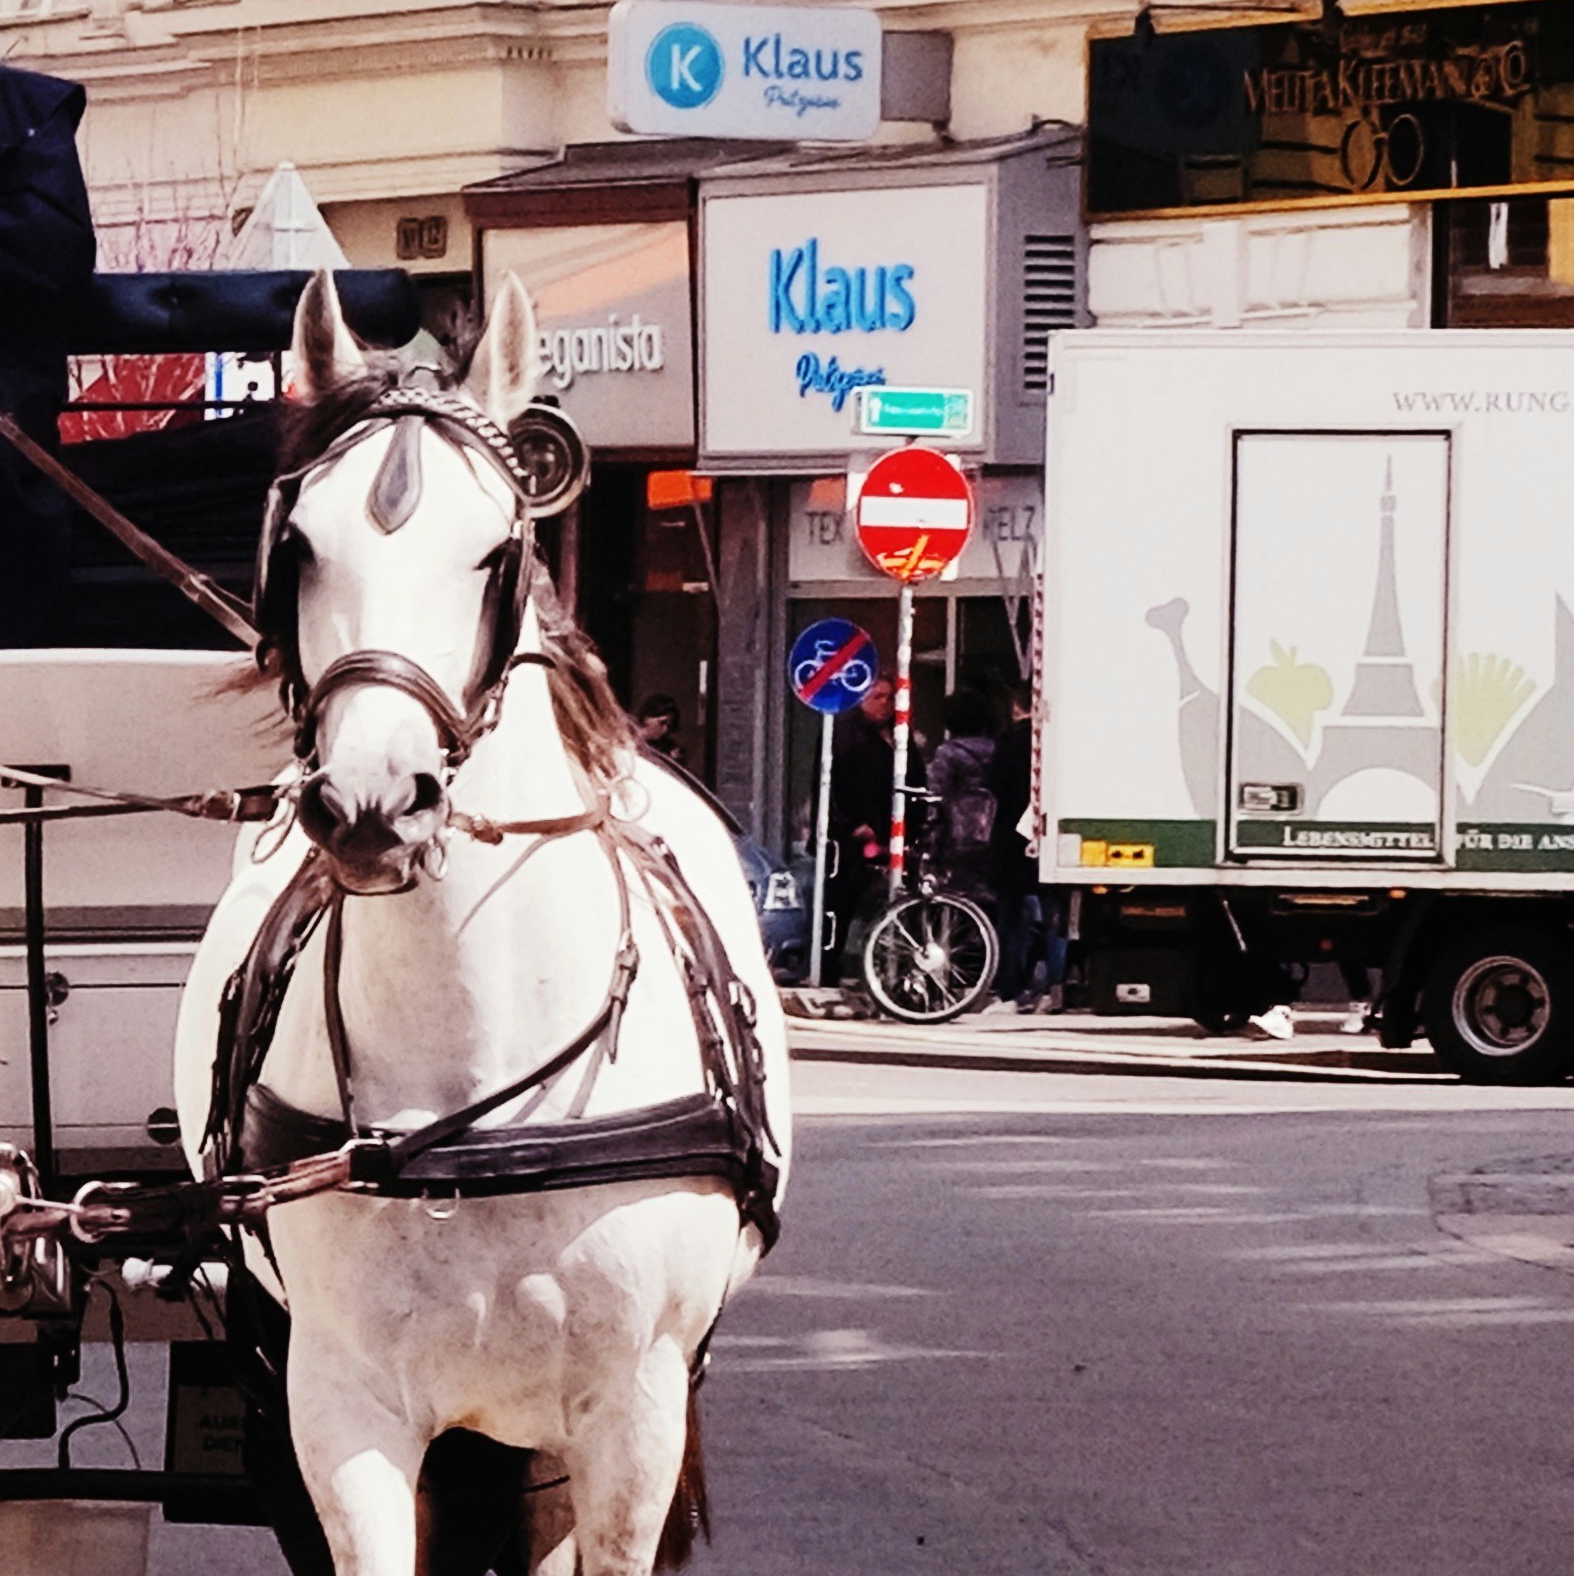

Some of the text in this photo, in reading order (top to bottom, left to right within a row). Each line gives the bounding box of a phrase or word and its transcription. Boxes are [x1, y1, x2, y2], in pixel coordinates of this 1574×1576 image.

[670, 42, 703, 93] K
[742, 32, 864, 82] Klaus
[768, 236, 916, 335] Klaus
[537, 312, 664, 390] eganista
[1497, 833, 1533, 850] DIE
